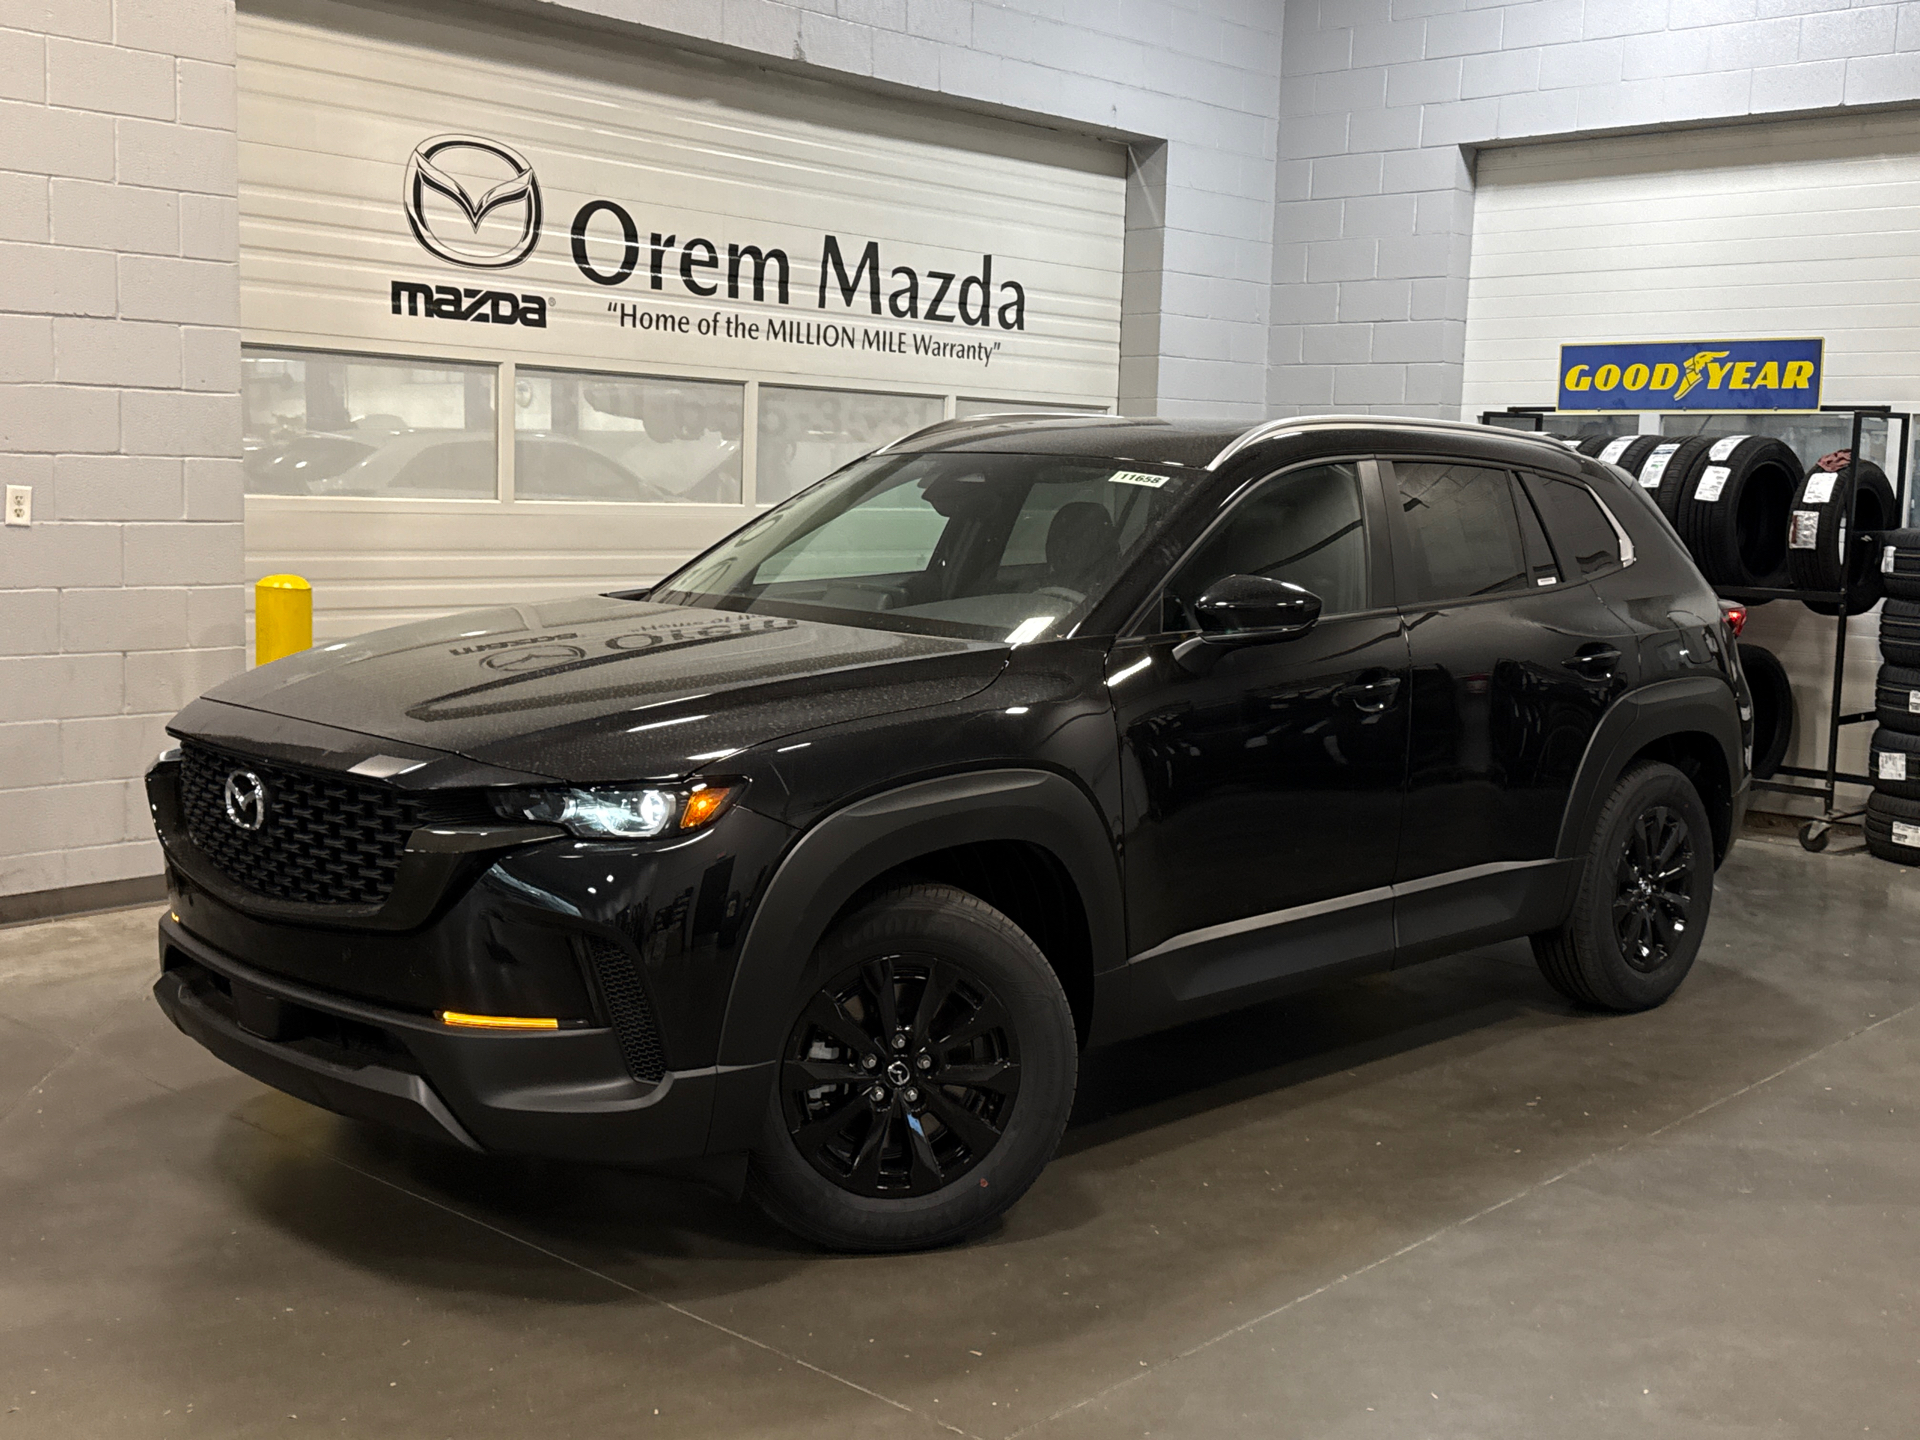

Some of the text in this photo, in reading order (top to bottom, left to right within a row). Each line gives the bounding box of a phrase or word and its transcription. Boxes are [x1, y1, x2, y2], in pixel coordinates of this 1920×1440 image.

[570, 200, 1026, 331] Orem Mazda
[697, 311, 721, 336] of
[725, 314, 760, 340] the
[766, 318, 856, 350] MILLION
[861, 328, 907, 354] MILE
[1119, 473, 1162, 484] 11658
